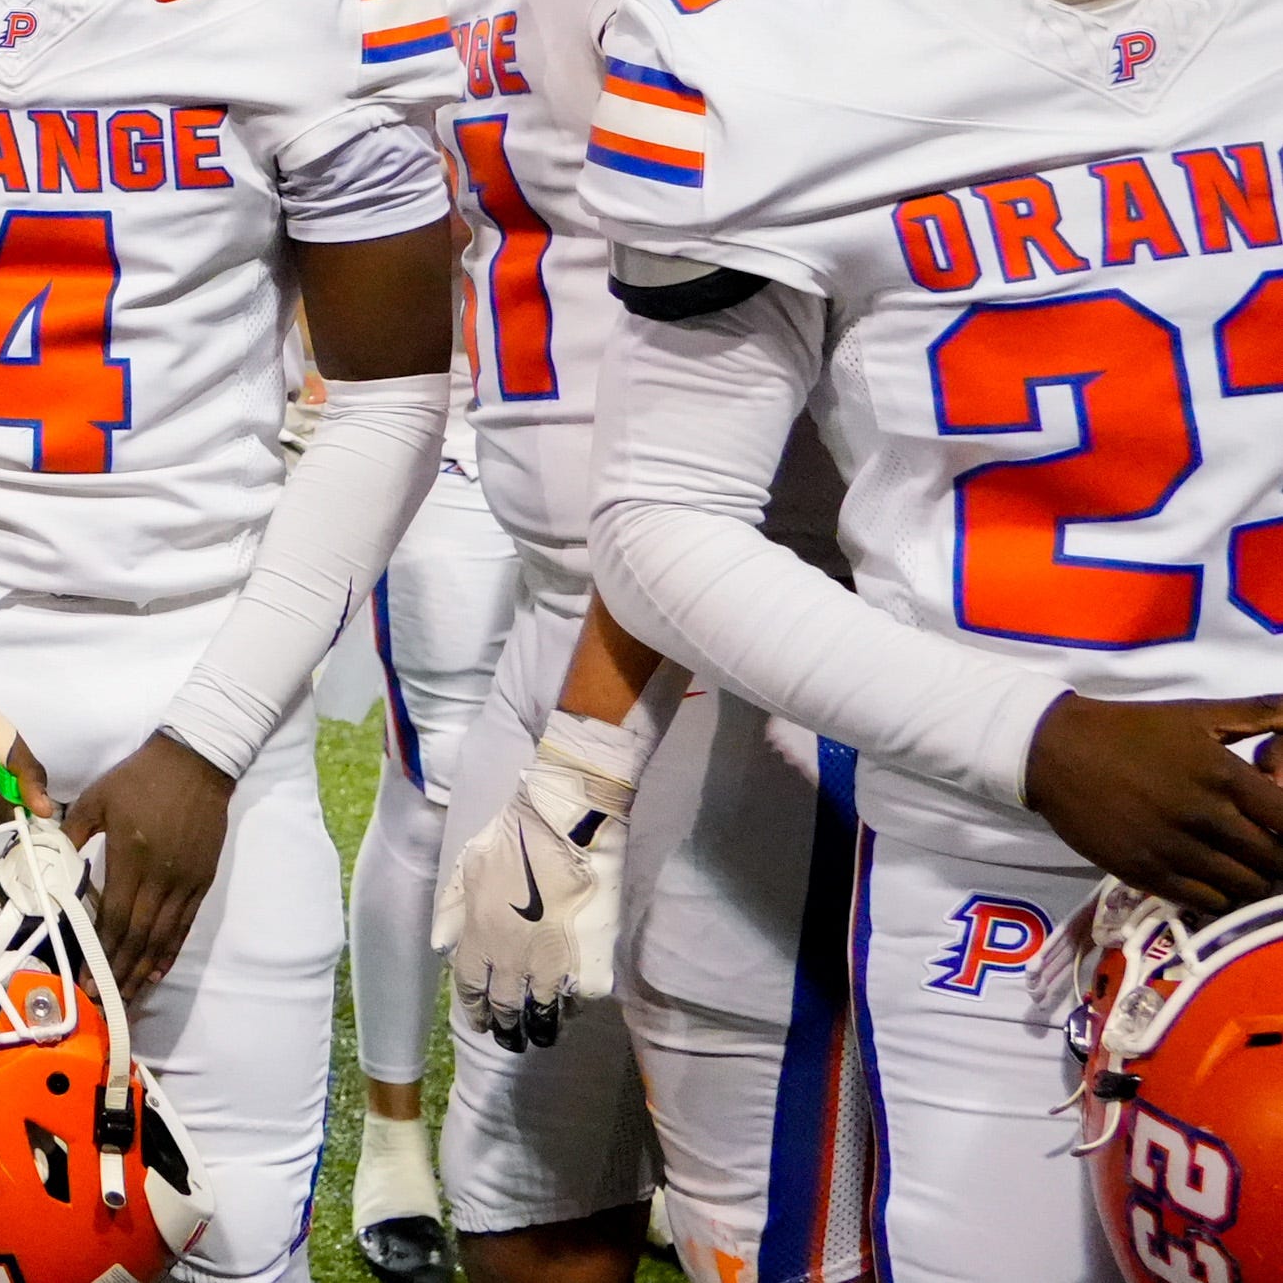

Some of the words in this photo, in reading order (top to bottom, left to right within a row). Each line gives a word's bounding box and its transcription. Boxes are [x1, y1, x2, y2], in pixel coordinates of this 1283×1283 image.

[1109, 30, 1157, 85] P
[890, 142, 1283, 292] ORAN
[926, 894, 1054, 997] P
